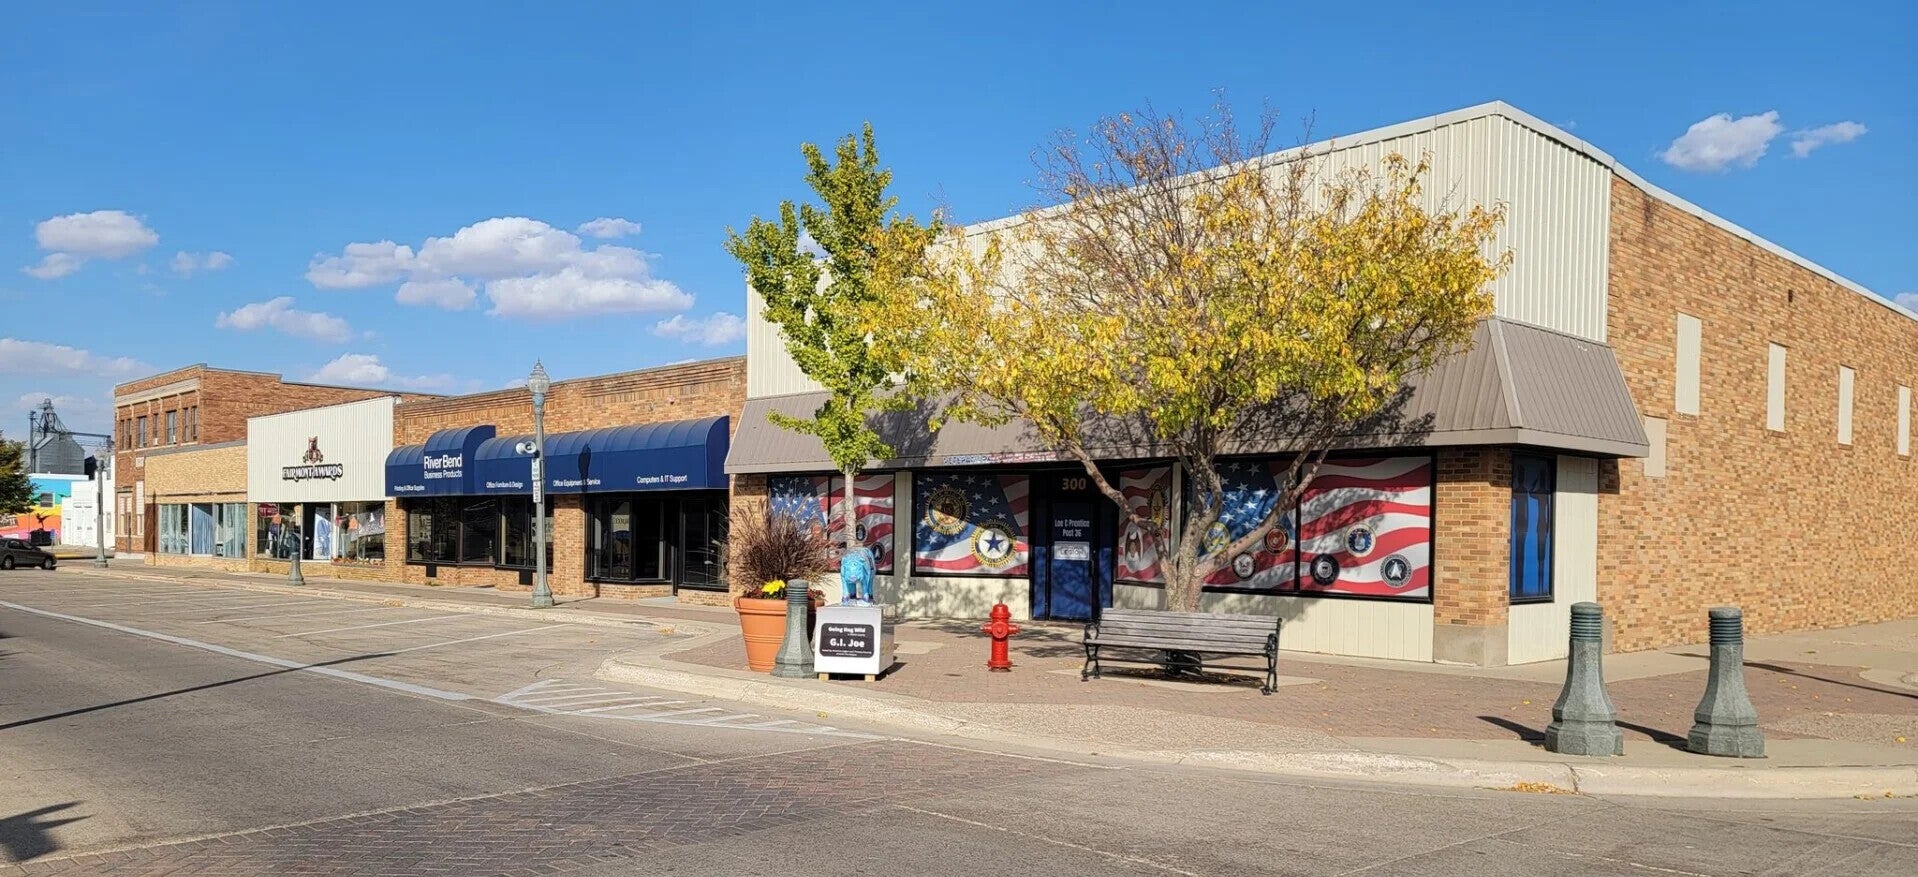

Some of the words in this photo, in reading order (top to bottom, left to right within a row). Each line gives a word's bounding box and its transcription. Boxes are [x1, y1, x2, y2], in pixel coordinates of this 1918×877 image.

[424, 455, 442, 470] River
[442, 453, 463, 468] Bend
[282, 466, 313, 481] FAIRMONT
[313, 464, 343, 480] AWARDS
[424, 471, 443, 479] Business
[443, 469, 463, 478] Products
[563, 479, 582, 487] Equipment
[637, 476, 659, 484] Computers
[669, 474, 687, 483] Support
[1062, 478, 1086, 490] 300
[486, 481, 495, 489] Office
[511, 480, 523, 489] Design
[1069, 518, 1090, 528] Prentice
[1062, 528, 1074, 537] Post
[1074, 529, 1082, 537] 36
[830, 638, 846, 647] G.I.
[848, 638, 865, 648] Joe
